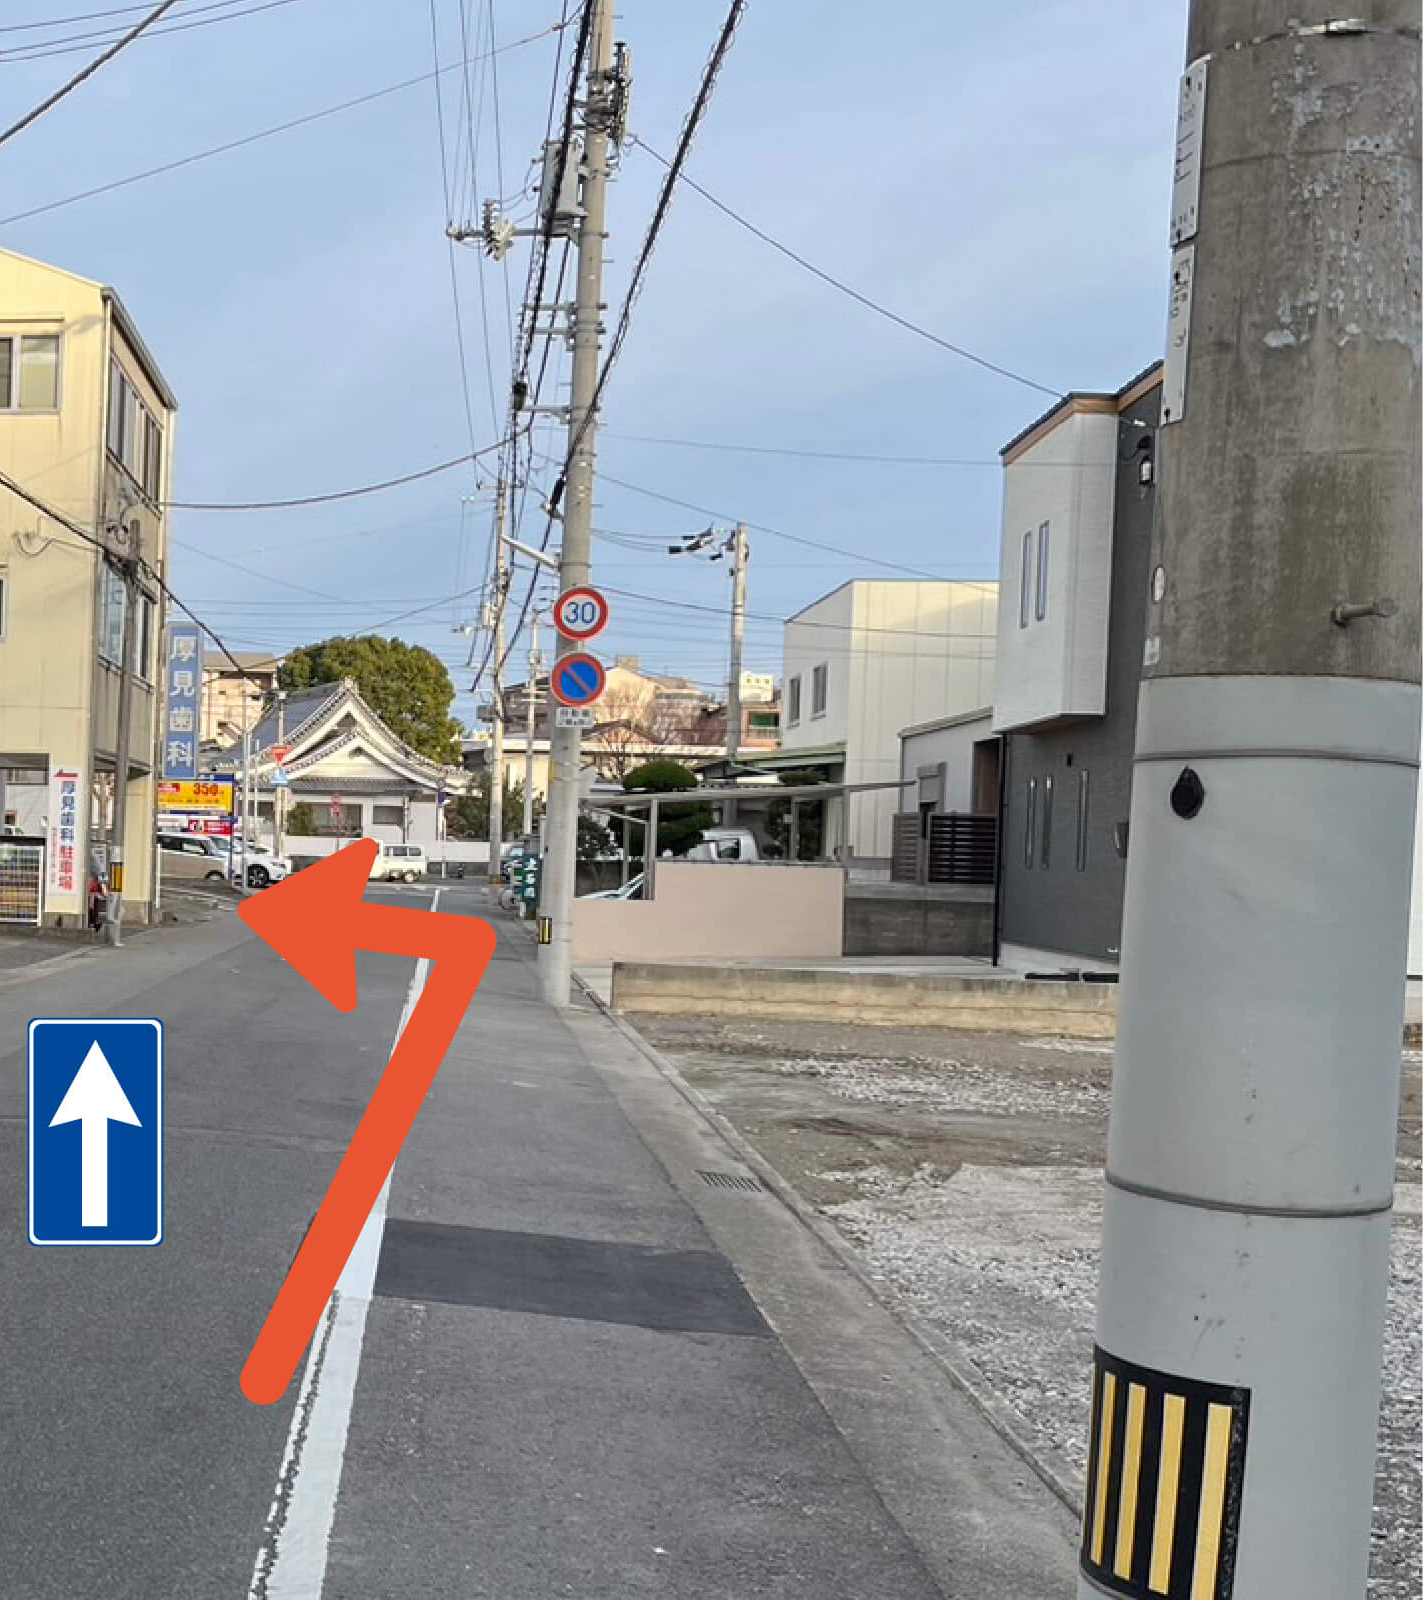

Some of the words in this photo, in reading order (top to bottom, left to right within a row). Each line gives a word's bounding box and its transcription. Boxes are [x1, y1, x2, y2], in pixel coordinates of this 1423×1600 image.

[565, 602, 595, 623] 30
[167, 636, 196, 768] 厚見歯科
